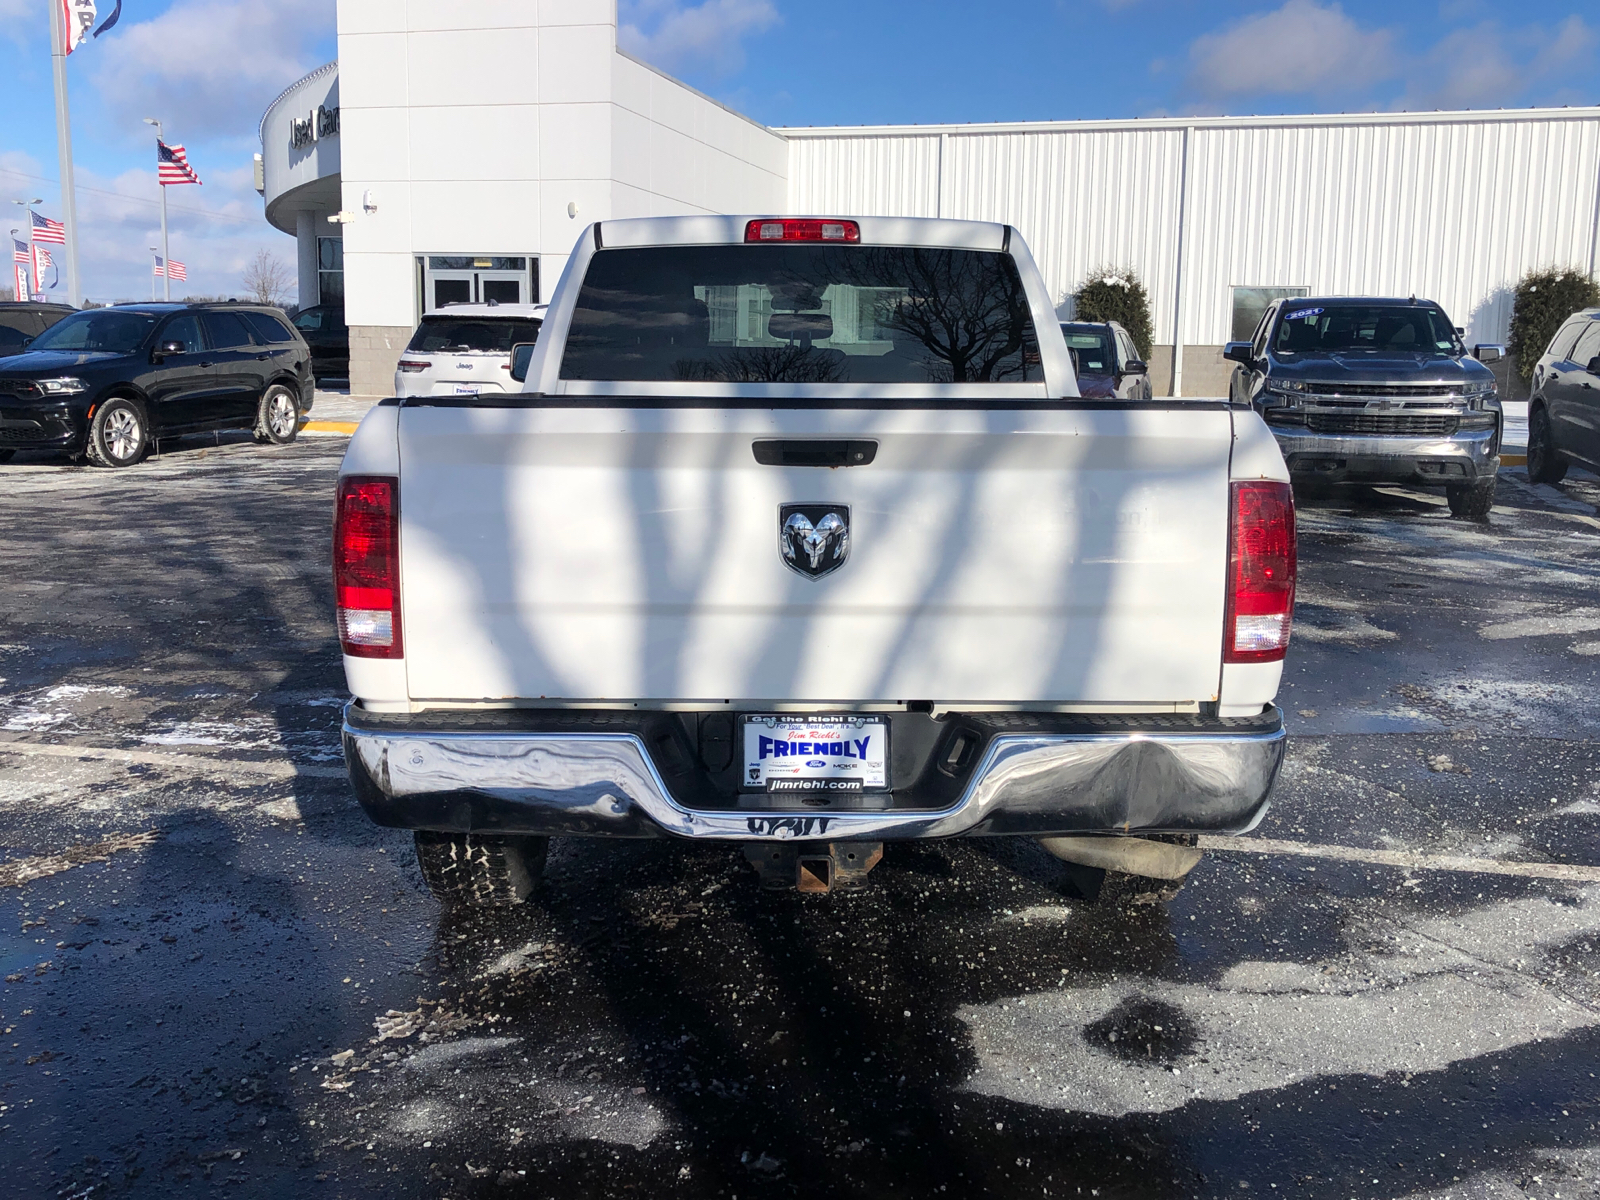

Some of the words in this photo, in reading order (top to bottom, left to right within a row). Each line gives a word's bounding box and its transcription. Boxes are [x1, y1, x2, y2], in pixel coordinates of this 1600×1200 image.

[290, 109, 317, 149] Used
[318, 104, 340, 138] Car
[1290, 308, 1319, 319] 2021
[456, 362, 473, 370] Jeep
[787, 723, 804, 731] Your
[787, 731, 806, 741] Jim
[809, 731, 841, 739] Riehl's
[758, 734, 871, 760] FRIENDLY
[770, 780, 860, 791] jimriehl.com
